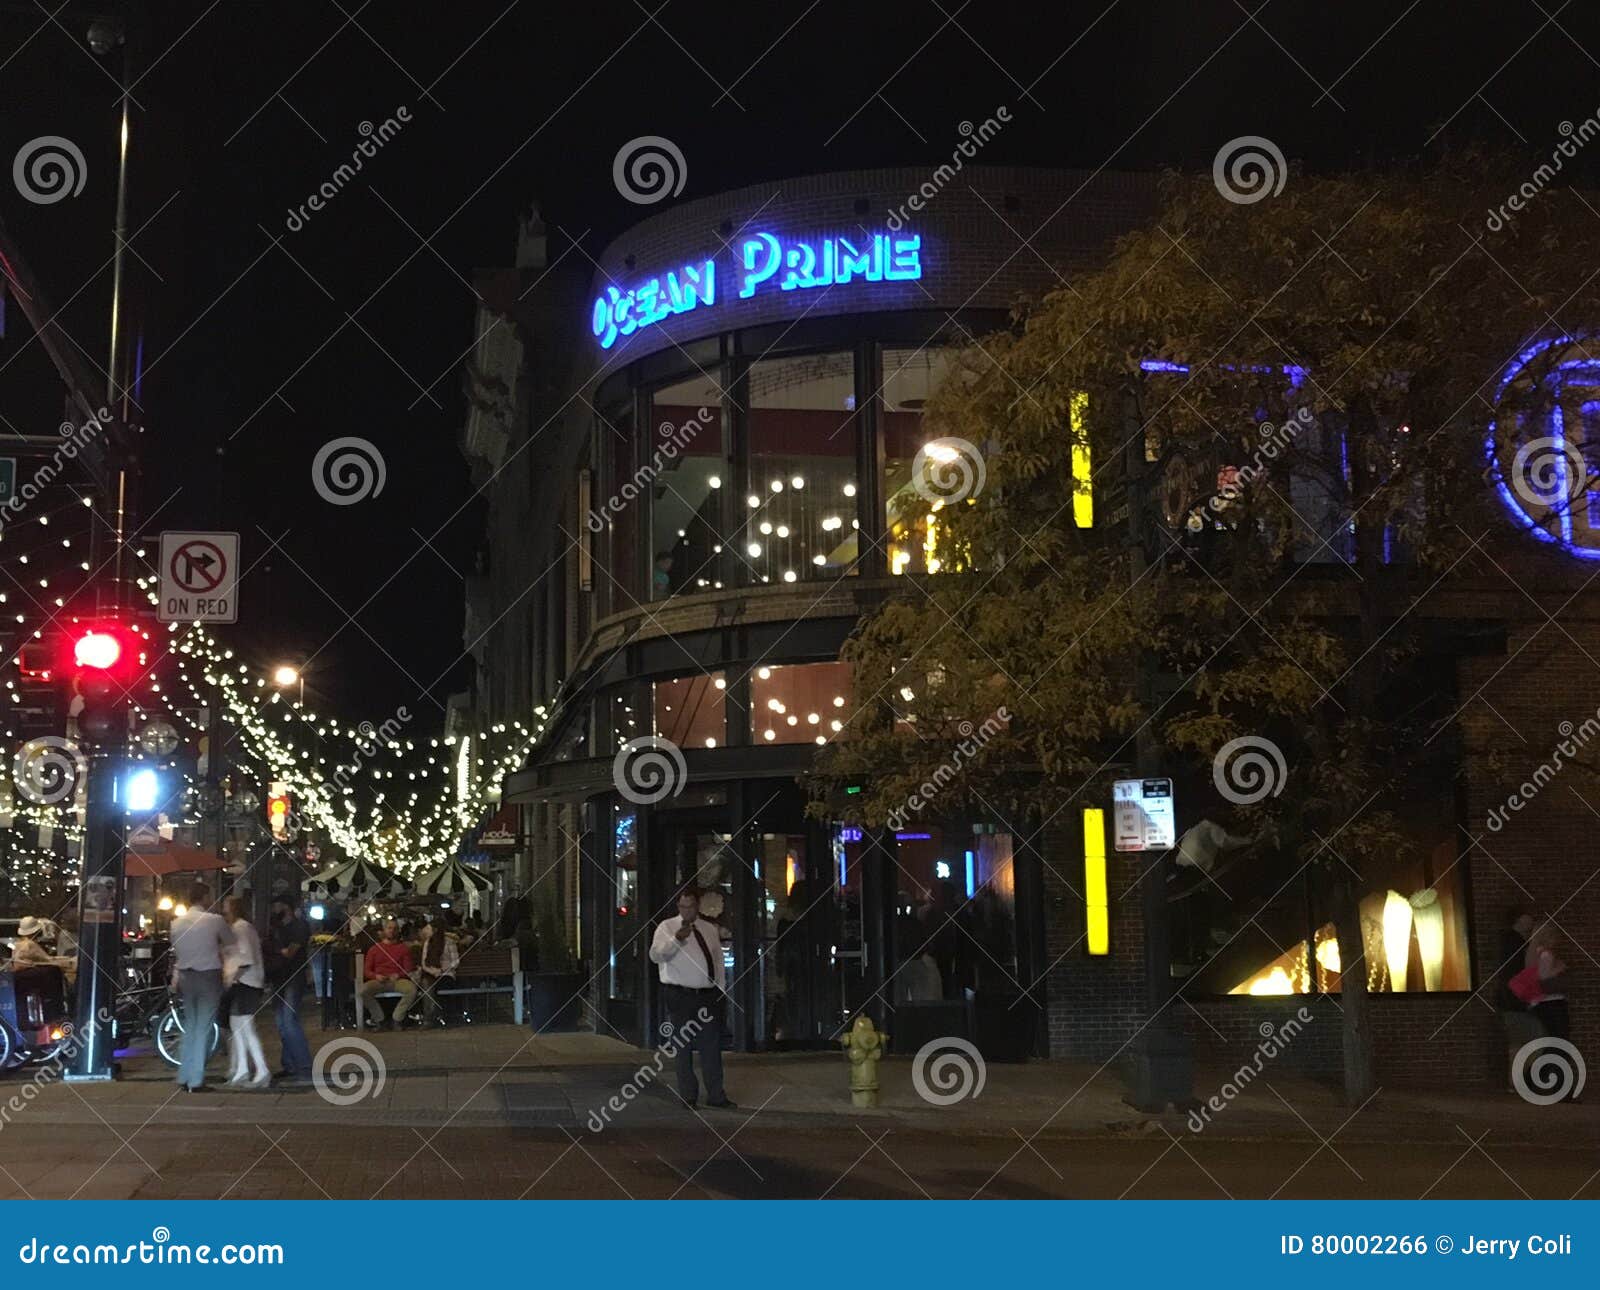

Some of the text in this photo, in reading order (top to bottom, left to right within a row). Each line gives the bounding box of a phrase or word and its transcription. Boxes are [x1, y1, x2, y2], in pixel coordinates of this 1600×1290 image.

[738, 230, 924, 299] PRIME
[167, 598, 228, 615] ON RED
